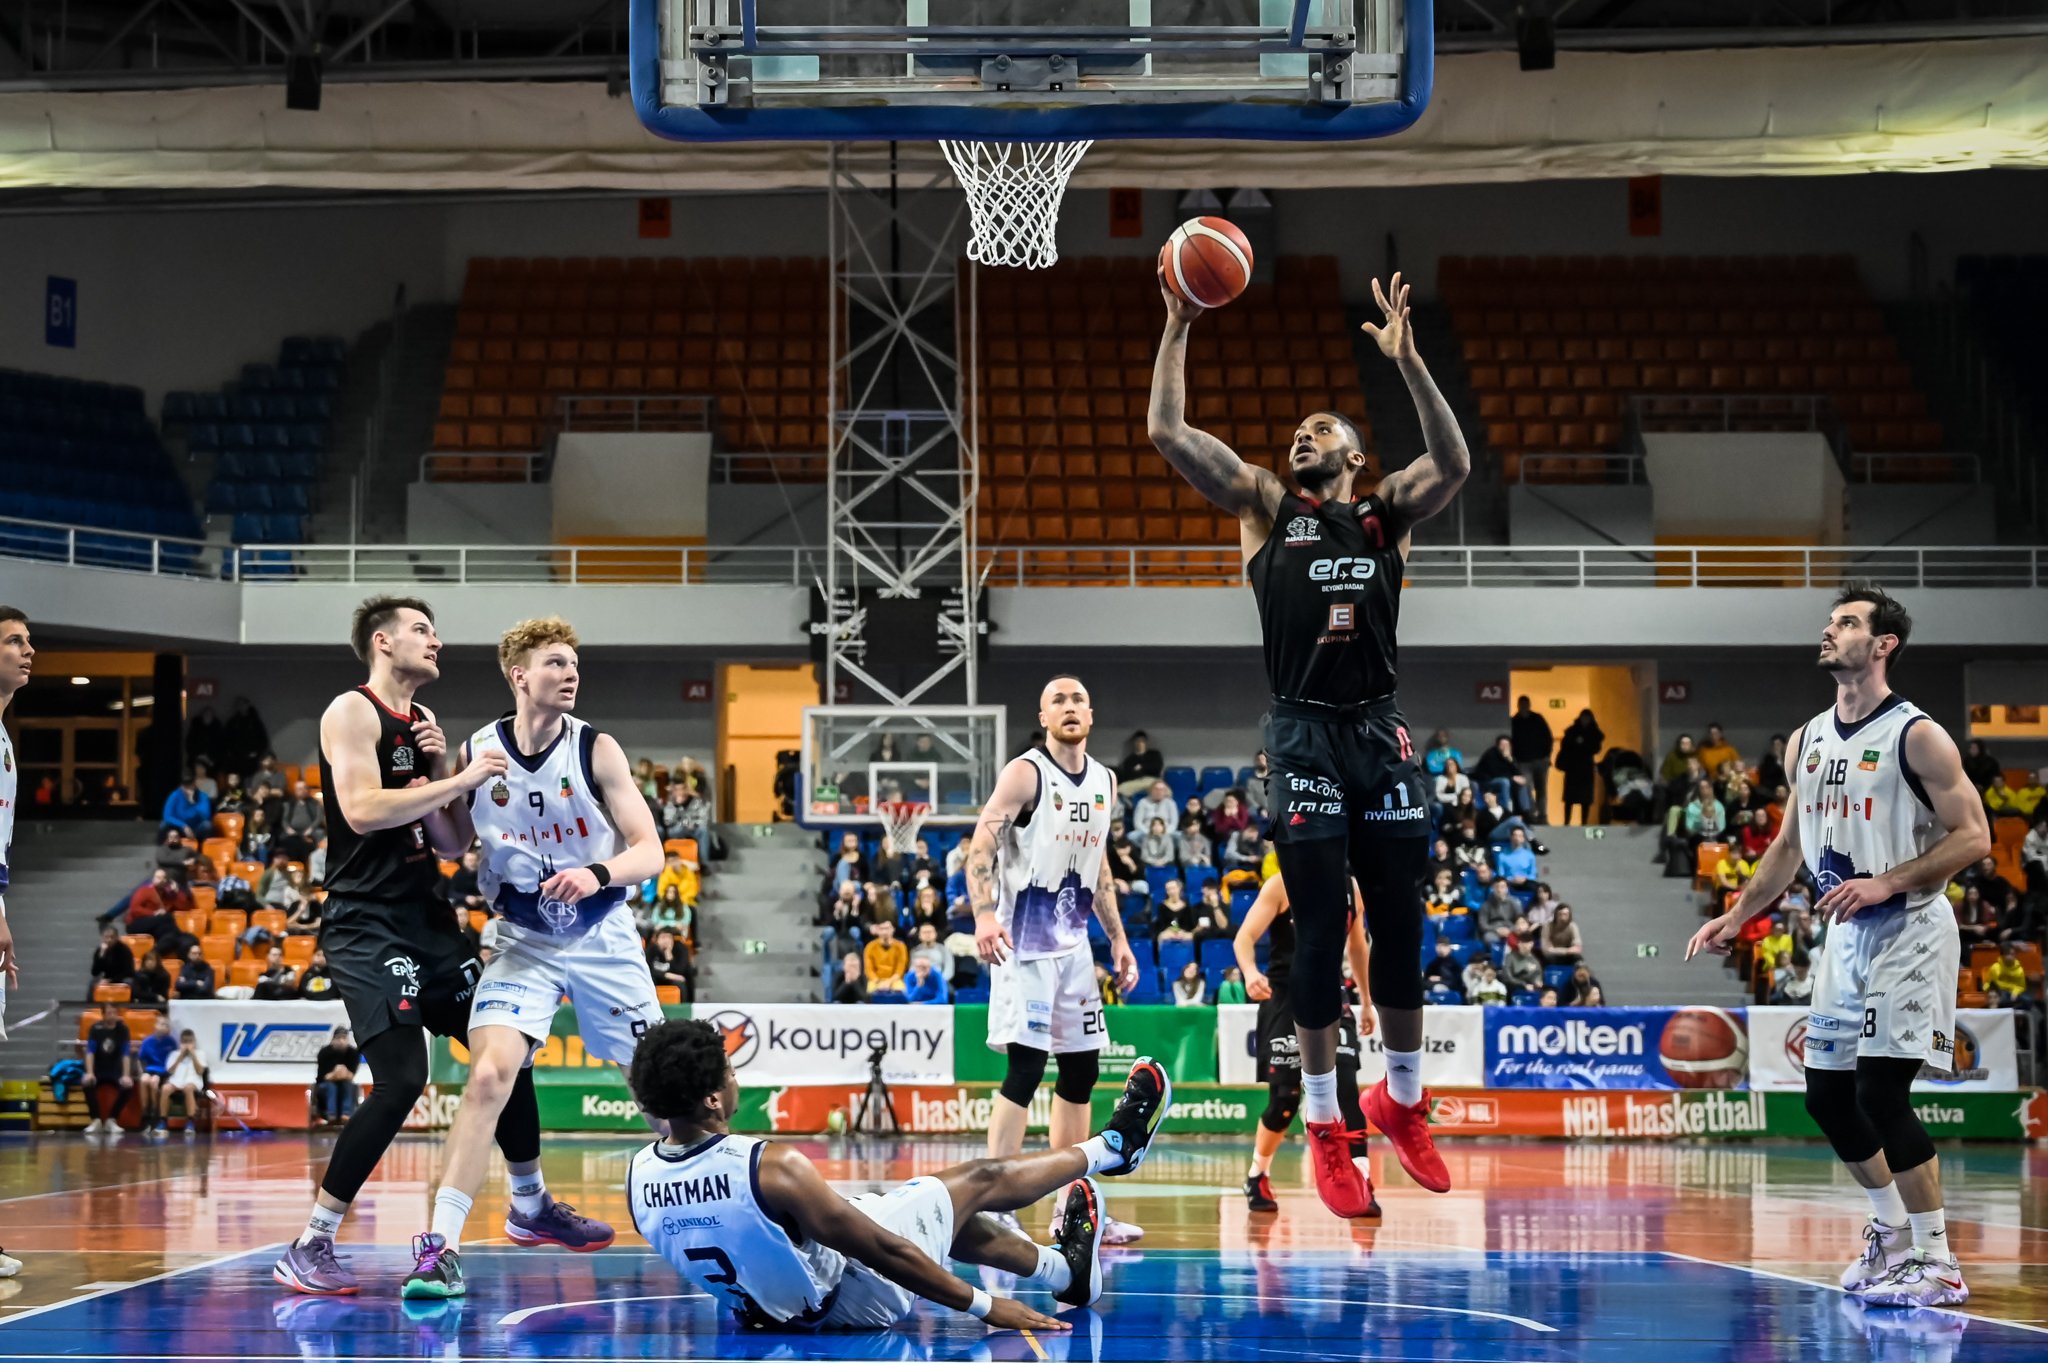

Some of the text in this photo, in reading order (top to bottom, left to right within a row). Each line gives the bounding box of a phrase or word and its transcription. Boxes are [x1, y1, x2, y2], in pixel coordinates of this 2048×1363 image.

[50, 294, 72, 328] B1
[1308, 557, 1376, 580] era
[1321, 583, 1365, 592] BEYOND RADAR
[196, 683, 214, 696] A1
[687, 684, 707, 698] A1
[1480, 685, 1502, 700] A2
[1665, 684, 1687, 699] A3
[1826, 759, 1848, 785] 18
[528, 791, 545, 817] 9
[1069, 802, 1089, 822] 20
[769, 1020, 944, 1060] koupelny
[1498, 1020, 1643, 1056] molten
[1494, 1058, 1524, 1076] For
[1525, 1057, 1552, 1075] the
[1592, 1063, 1644, 1080] game
[1562, 1091, 1767, 1137] NBL.basketball
[643, 1174, 732, 1208] CHATMAN
[678, 1216, 720, 1228] UNIKOL
